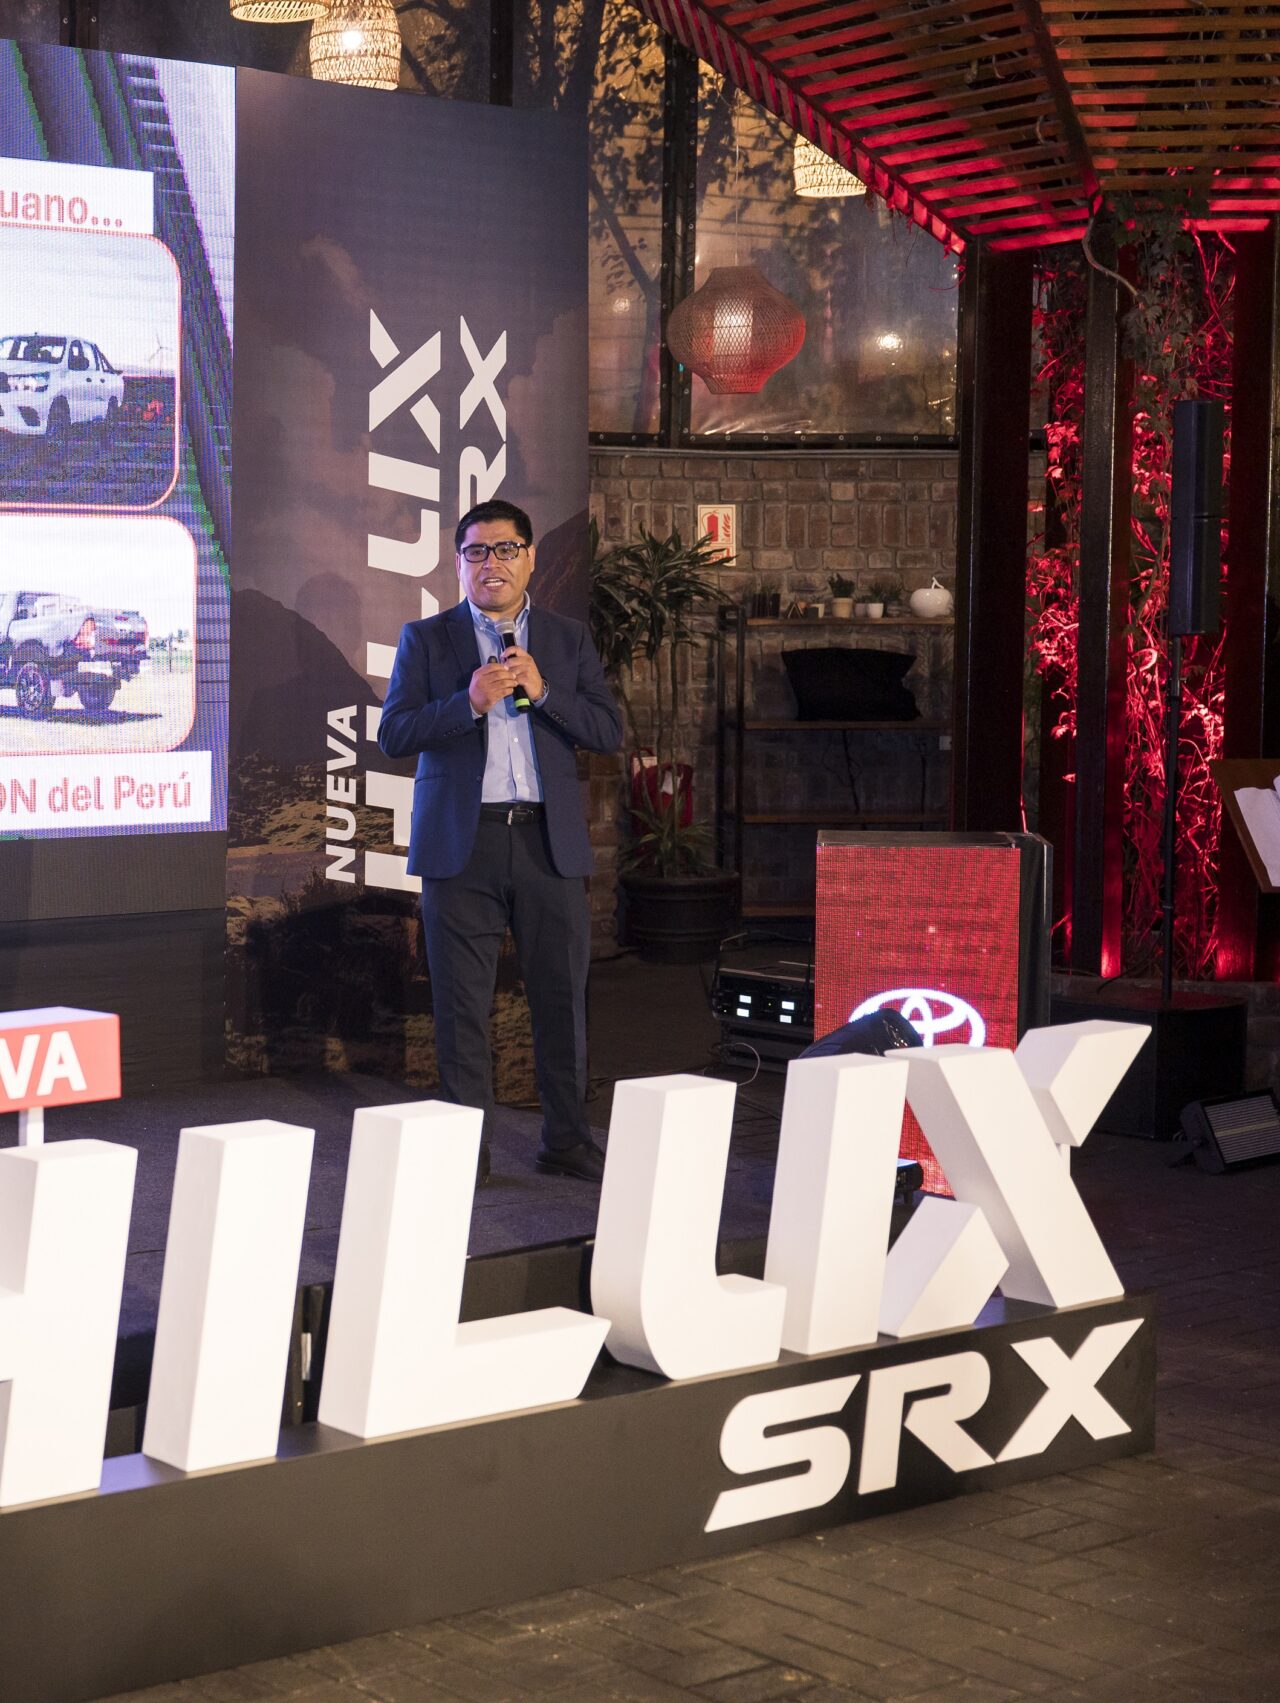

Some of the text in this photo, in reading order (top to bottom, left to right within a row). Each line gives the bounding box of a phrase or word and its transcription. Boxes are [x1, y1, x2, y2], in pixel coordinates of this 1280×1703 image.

[459, 314, 507, 598] RX
[364, 308, 441, 894] HUX
[47, 775, 104, 814] del
[114, 769, 192, 811] Perú
[324, 704, 358, 883] NUEVA
[703, 1317, 1146, 1534] SRX
